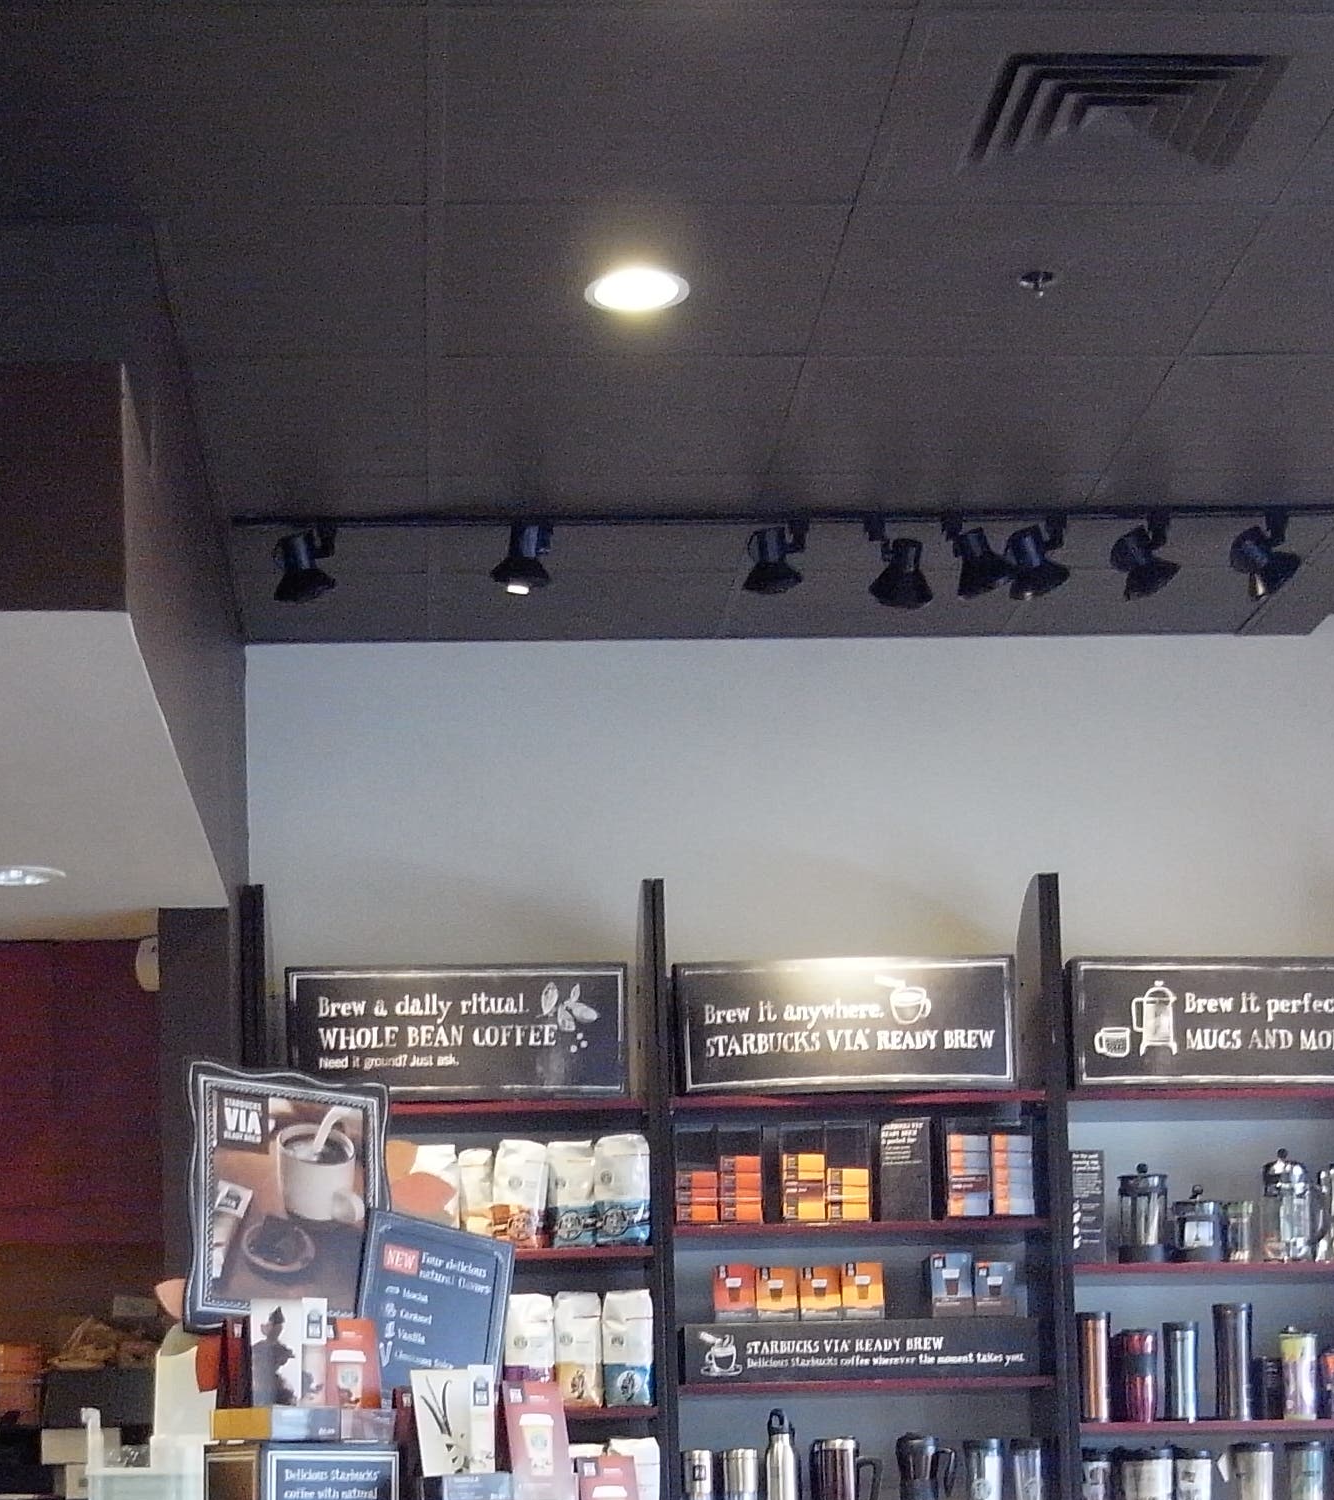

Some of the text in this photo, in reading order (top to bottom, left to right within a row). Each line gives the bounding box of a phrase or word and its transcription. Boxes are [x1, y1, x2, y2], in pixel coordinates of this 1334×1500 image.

[318, 995, 367, 1018] Brew
[373, 999, 387, 1017] a
[395, 993, 454, 1024] daily
[704, 998, 885, 1029] Brew it anywhere.
[1184, 991, 1233, 1014] Brew
[1240, 991, 1261, 1014] it
[318, 1023, 558, 1051] WHOLE BEAN COFFEE
[705, 1029, 820, 1058] STARBUCKS
[876, 1029, 940, 1051] READY
[944, 1028, 995, 1051] BREW
[1185, 1027, 1242, 1051] MUGS
[1249, 1027, 1293, 1051] AND
[319, 1055, 348, 1070] Need
[352, 1054, 361, 1068] it
[364, 1053, 407, 1071] ground?
[409, 1053, 434, 1068] Just
[224, 1107, 262, 1135] VIA
[386, 1248, 416, 1270] NEW
[746, 1339, 820, 1354] STARBUCKS
[855, 1338, 902, 1352] READY
[906, 1336, 944, 1350] BREW
[747, 1356, 789, 1369] Delicious
[918, 1353, 936, 1365] the
[284, 1468, 328, 1481] Delicious
[341, 1486, 378, 1500] natural
